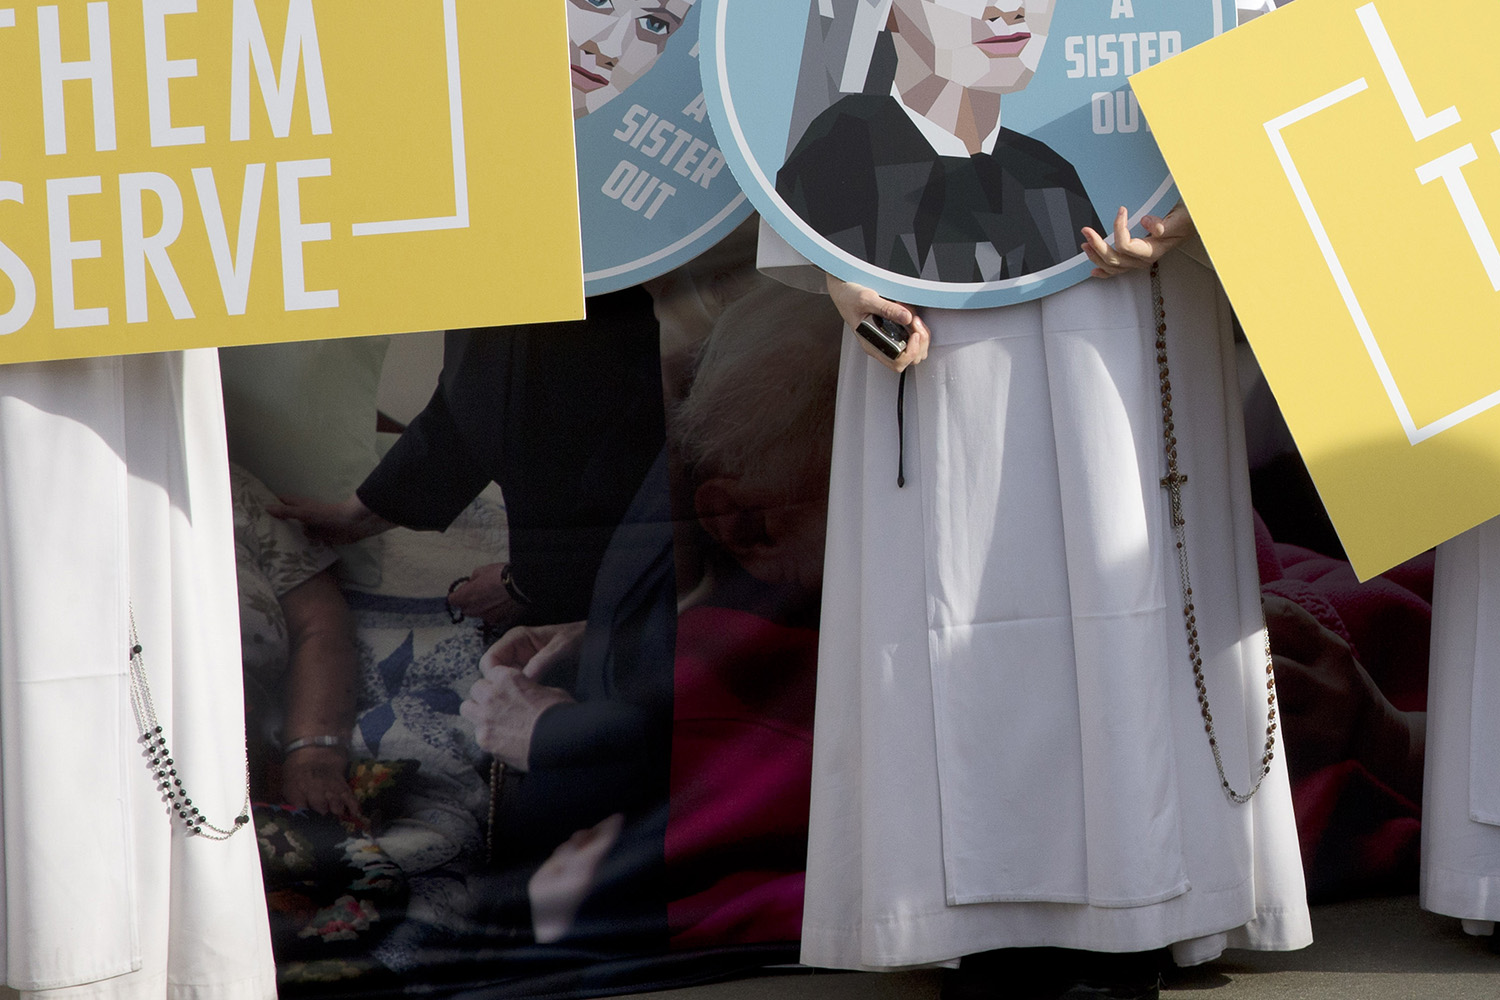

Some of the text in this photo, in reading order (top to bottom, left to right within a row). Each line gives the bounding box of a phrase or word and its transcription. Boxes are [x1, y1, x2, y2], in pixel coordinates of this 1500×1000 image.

[1091, 90, 1151, 135] OU
[613, 103, 726, 190] SISTER
[601, 159, 677, 221] OUT
